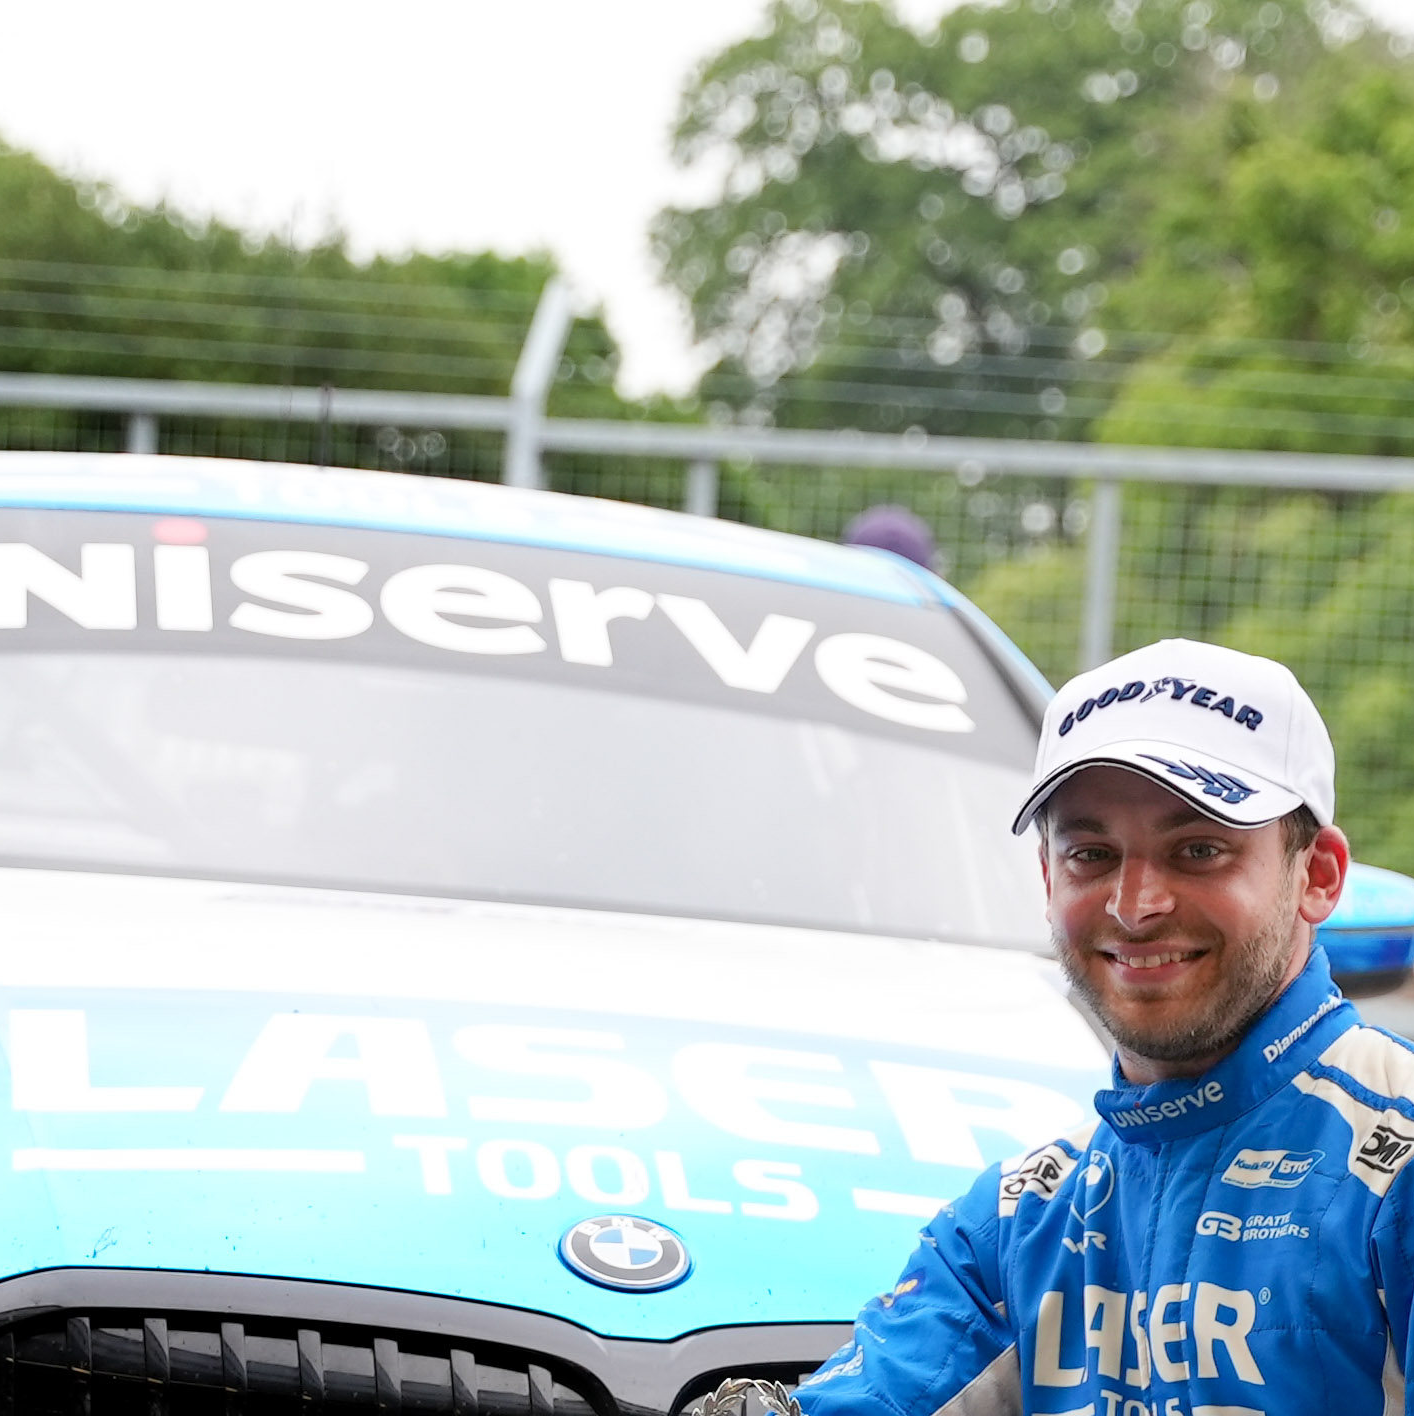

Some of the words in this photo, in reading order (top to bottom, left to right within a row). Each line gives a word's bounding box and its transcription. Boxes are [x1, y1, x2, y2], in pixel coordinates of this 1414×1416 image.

[1058, 677, 1264, 737] GOODYEAR
[9, 1007, 1085, 1172] LASER
[391, 1134, 820, 1222] TOOLS
[1242, 1224, 1310, 1242] BROTHERS
[1033, 1281, 1266, 1390] LASER
